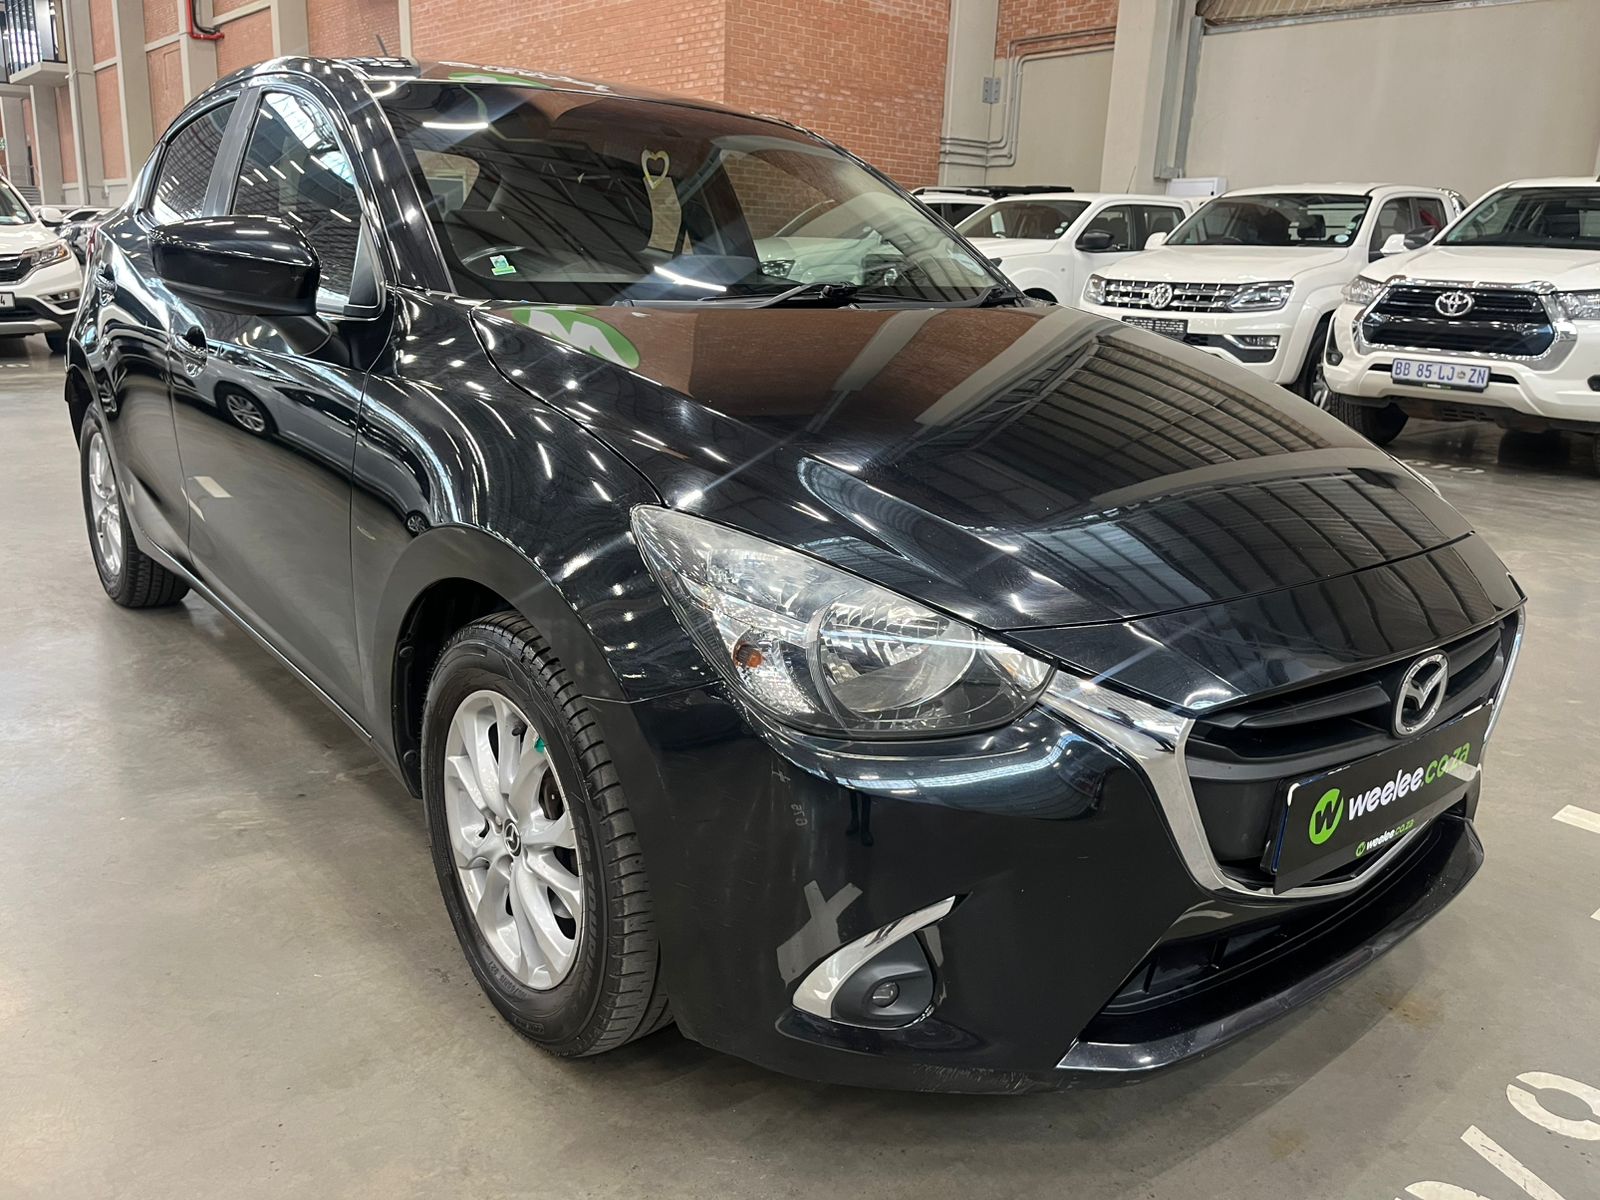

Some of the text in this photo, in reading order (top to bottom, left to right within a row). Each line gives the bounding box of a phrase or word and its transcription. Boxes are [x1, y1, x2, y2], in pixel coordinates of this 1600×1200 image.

[1395, 361, 1486, 384] BB 85 LJ ZN
